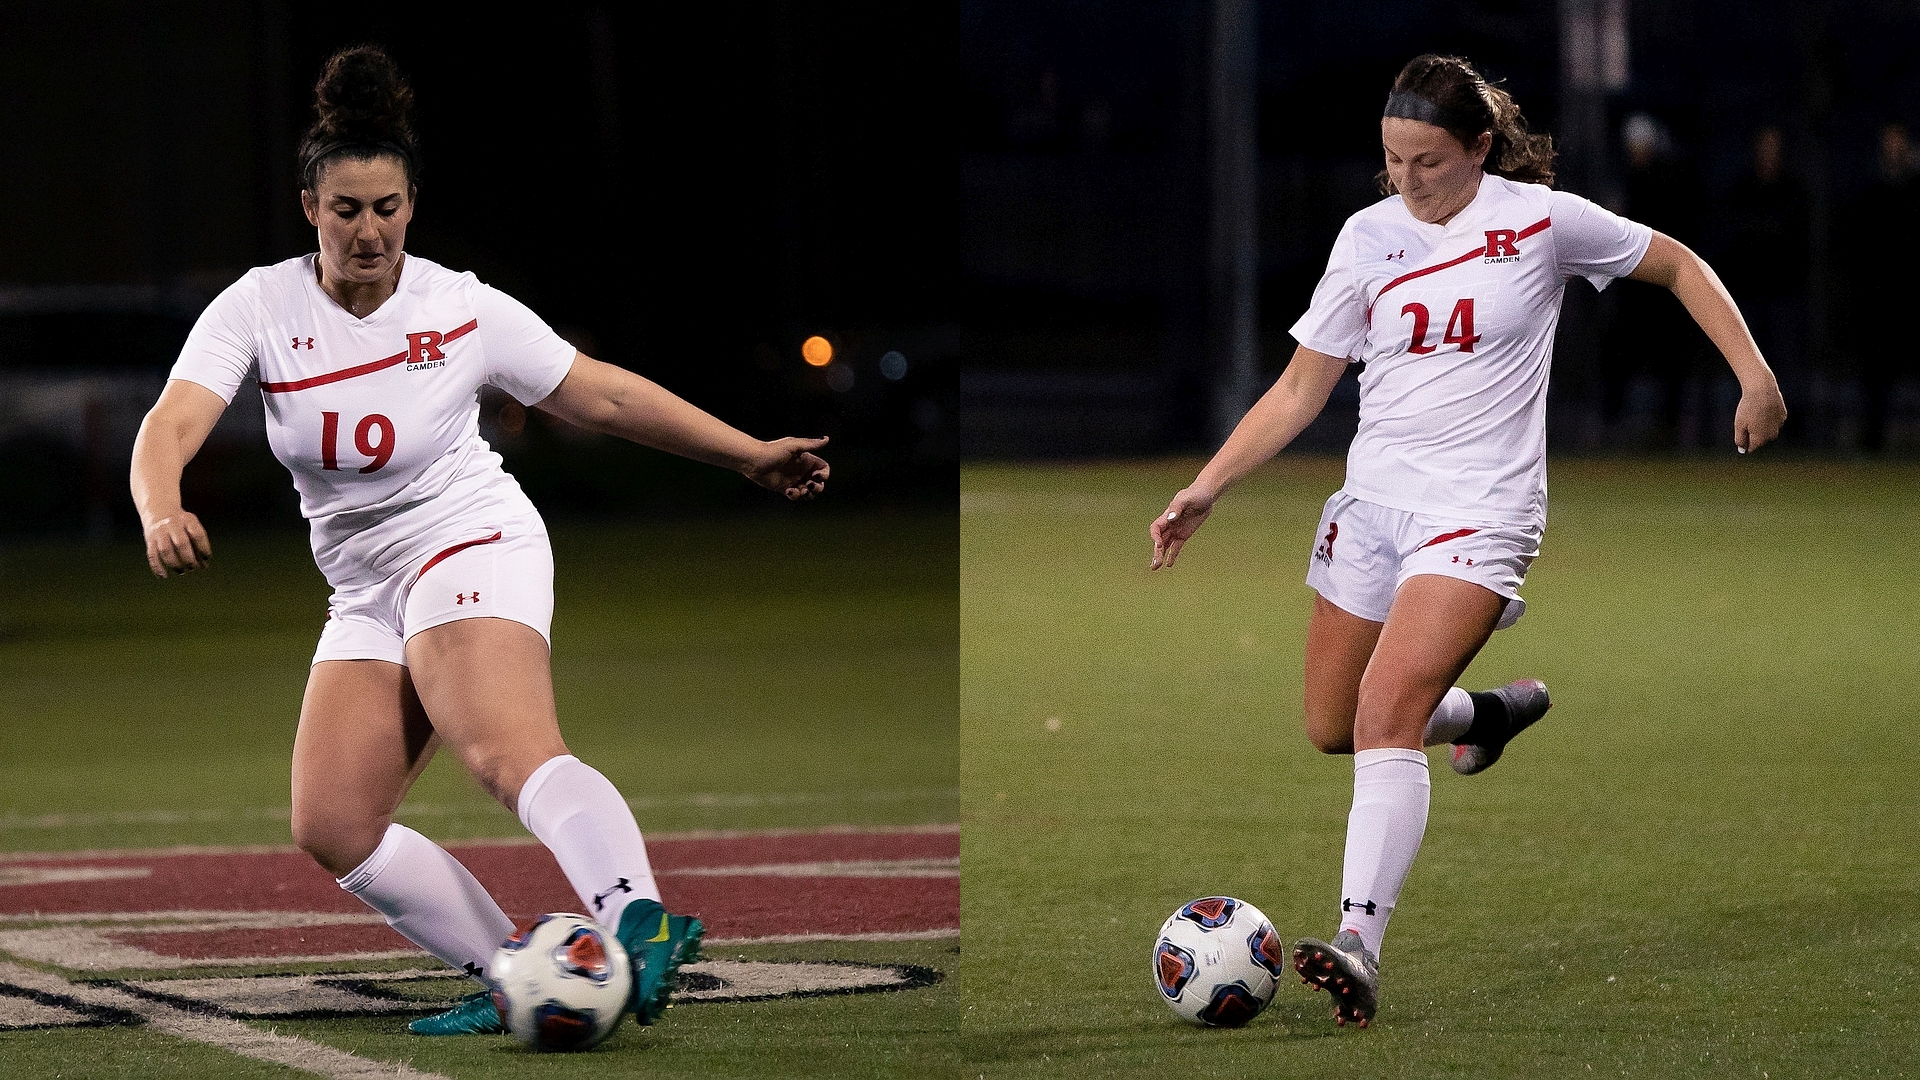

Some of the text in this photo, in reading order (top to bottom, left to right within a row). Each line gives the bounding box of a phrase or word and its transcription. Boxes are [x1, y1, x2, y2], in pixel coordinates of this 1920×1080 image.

[1485, 229, 1520, 257] R
[1484, 256, 1520, 264] CAMDEN
[1400, 298, 1483, 355] 24
[406, 331, 445, 364] R
[406, 361, 446, 372] CAMDEN
[321, 411, 396, 474] 19
